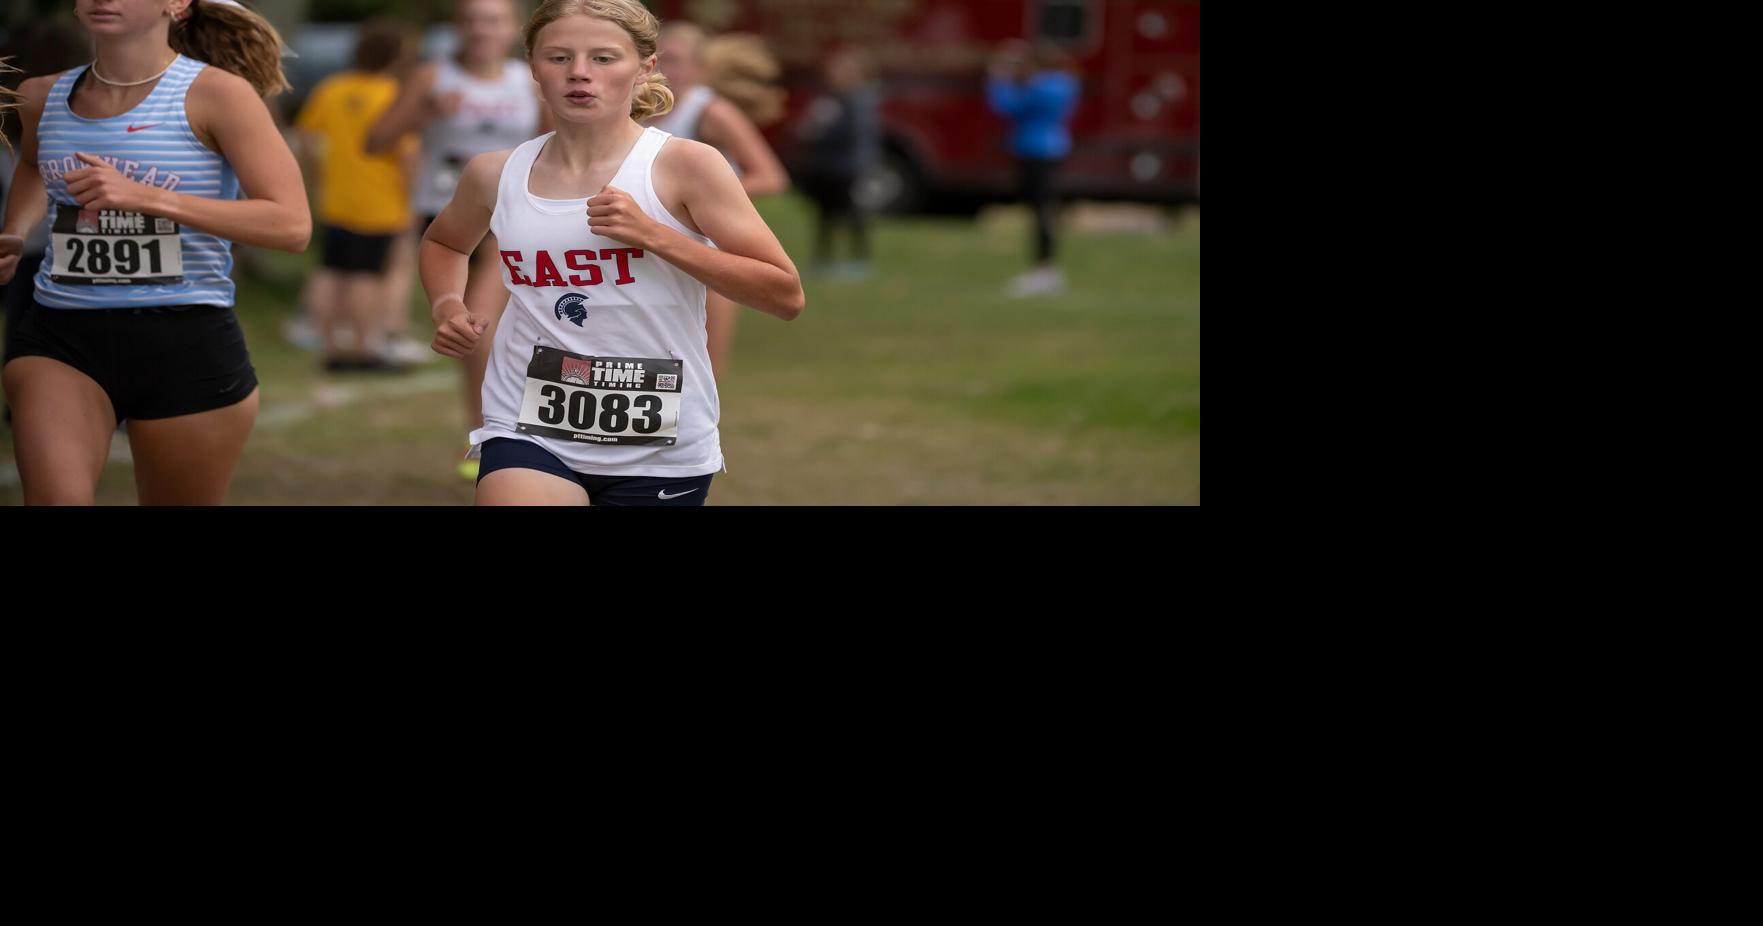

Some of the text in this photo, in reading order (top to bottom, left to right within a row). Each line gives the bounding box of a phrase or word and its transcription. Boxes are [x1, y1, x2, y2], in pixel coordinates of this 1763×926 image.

[98, 215, 146, 229] TIME
[66, 237, 162, 275] 2891
[500, 247, 644, 287] EAST
[595, 361, 643, 370] PRIME
[591, 366, 645, 383] TIME
[593, 381, 641, 389] TIMING
[537, 384, 663, 434] 3083
[573, 433, 618, 442] pttiming.com
